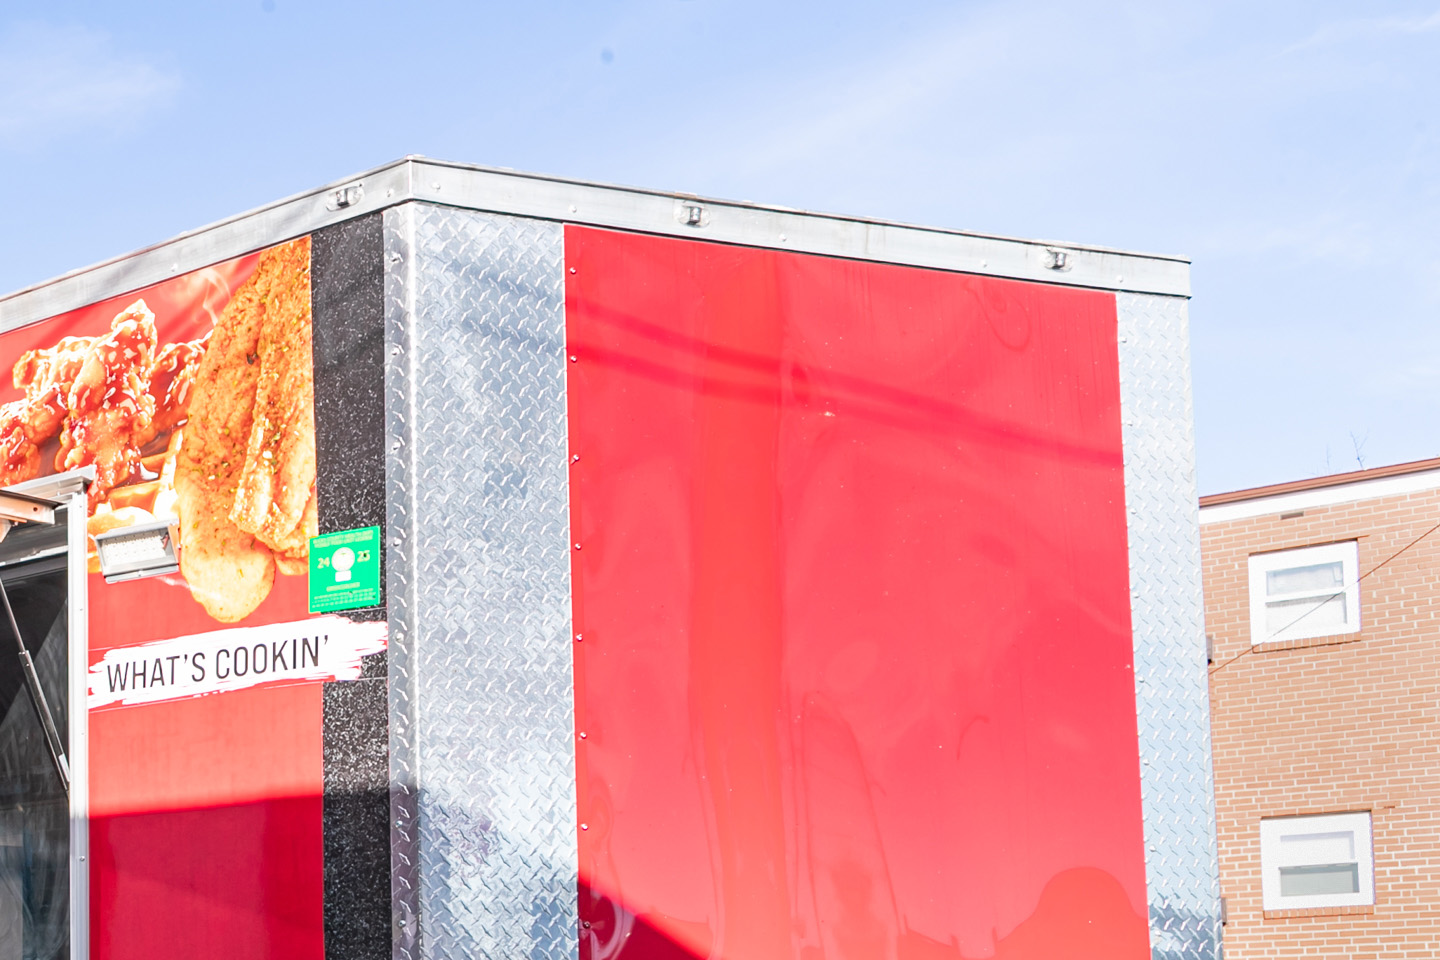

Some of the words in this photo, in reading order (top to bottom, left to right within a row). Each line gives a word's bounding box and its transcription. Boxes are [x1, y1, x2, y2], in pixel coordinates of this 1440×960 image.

[317, 557, 330, 569] 24
[357, 550, 370, 562] 25
[107, 652, 206, 693] WHAT'S
[216, 635, 328, 679] COOKIN'
